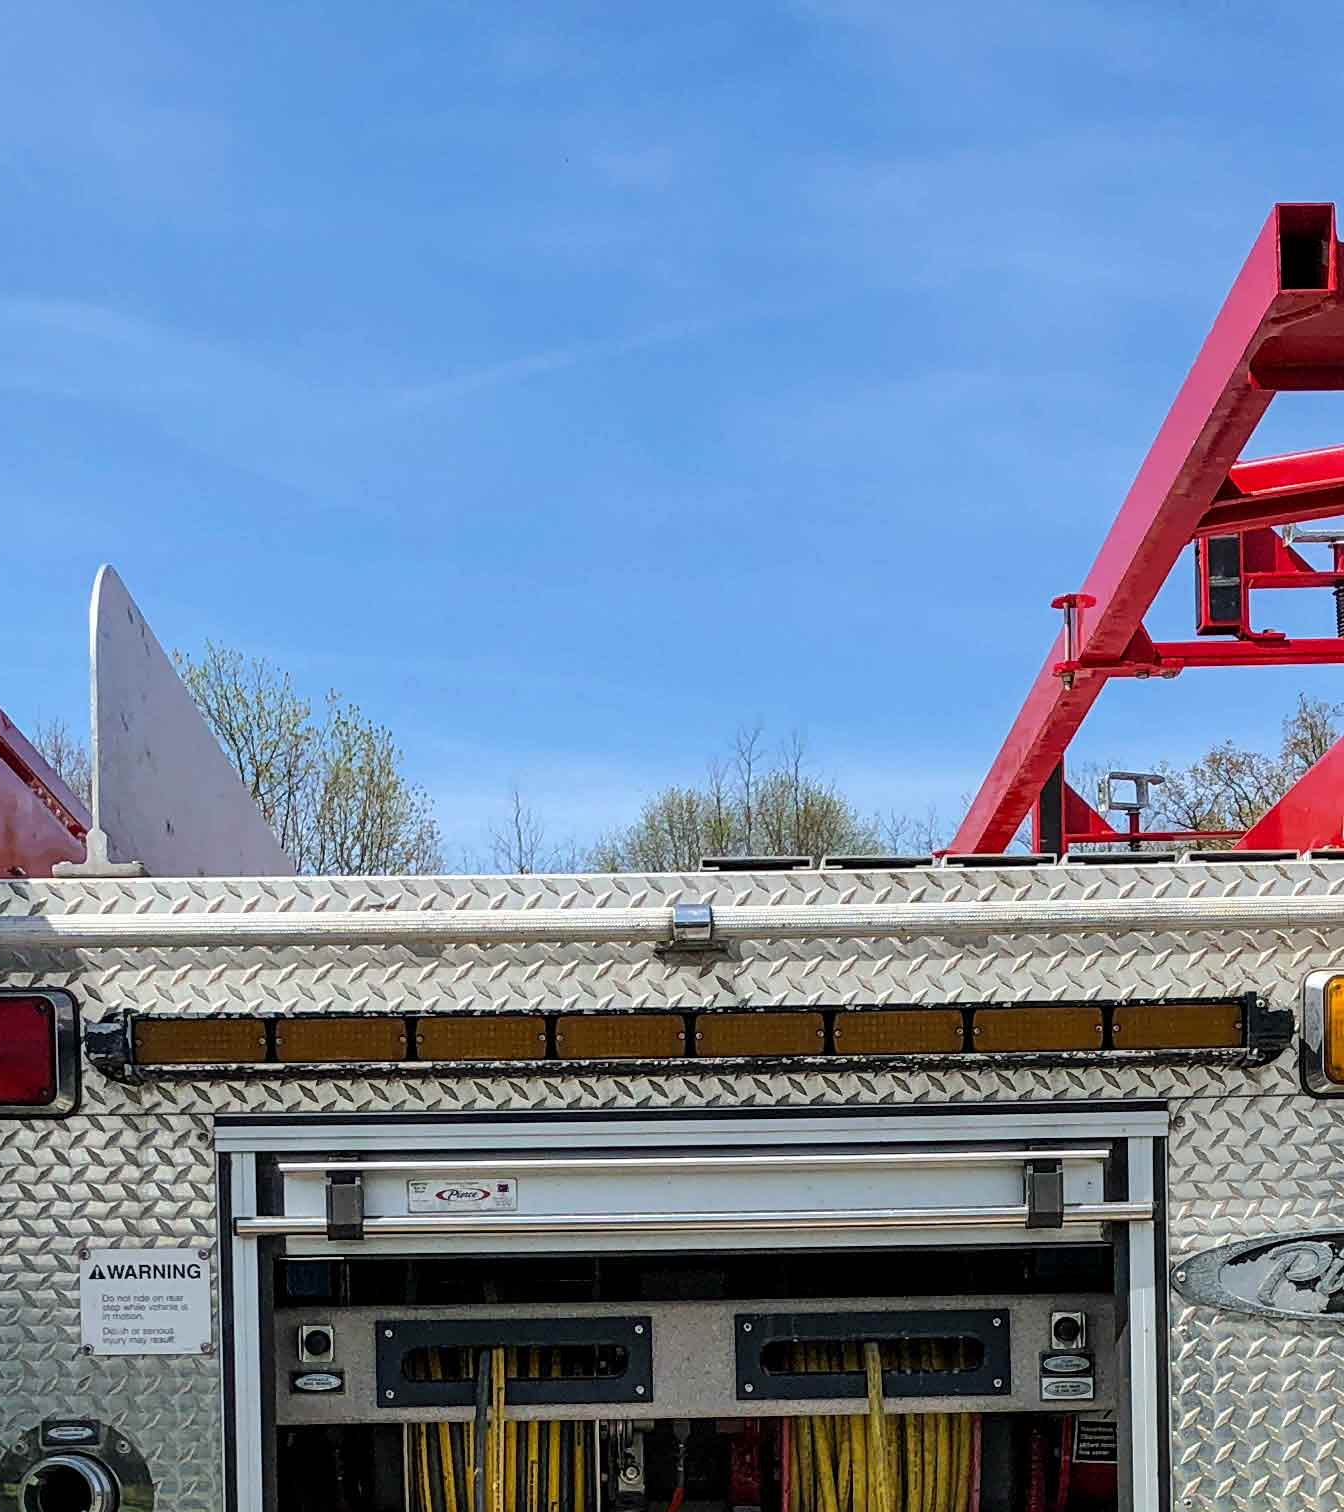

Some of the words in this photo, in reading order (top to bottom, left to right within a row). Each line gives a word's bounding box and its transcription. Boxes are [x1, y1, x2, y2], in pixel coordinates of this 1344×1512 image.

[447, 1189, 479, 1201] Pierce
[106, 1263, 201, 1280] WARNING
[102, 1294, 115, 1302] Do
[117, 1294, 131, 1302] not
